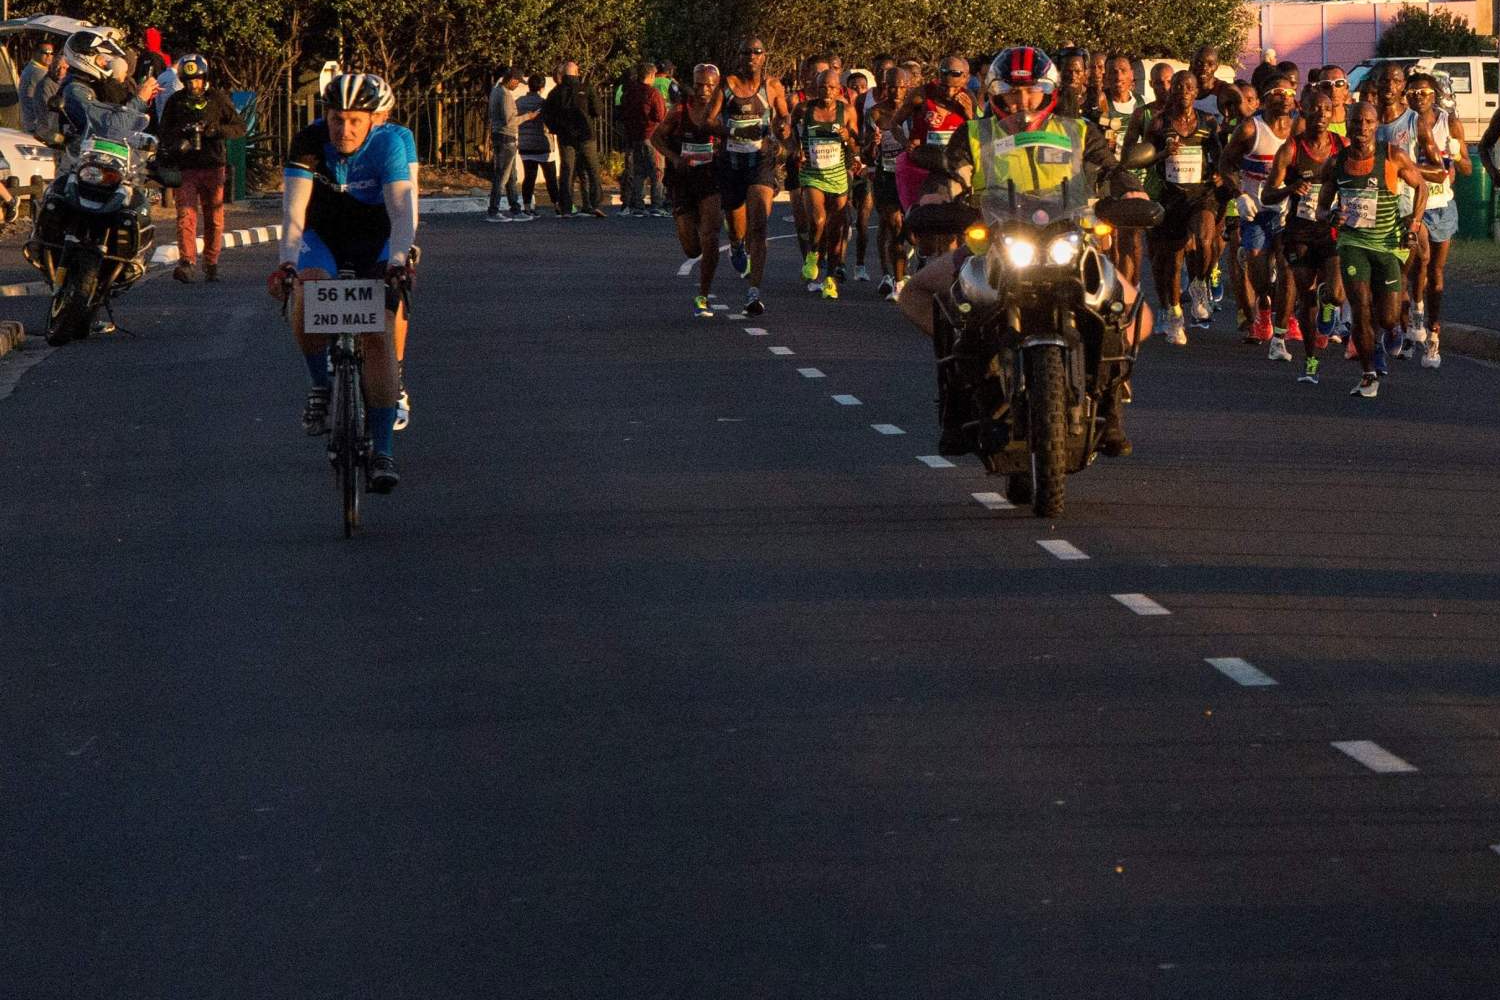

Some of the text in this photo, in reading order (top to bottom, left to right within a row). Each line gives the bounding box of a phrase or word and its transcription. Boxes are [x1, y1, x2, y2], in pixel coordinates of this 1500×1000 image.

[317, 287, 373, 302] 56 KM
[313, 313, 377, 326] 2ND MALE
